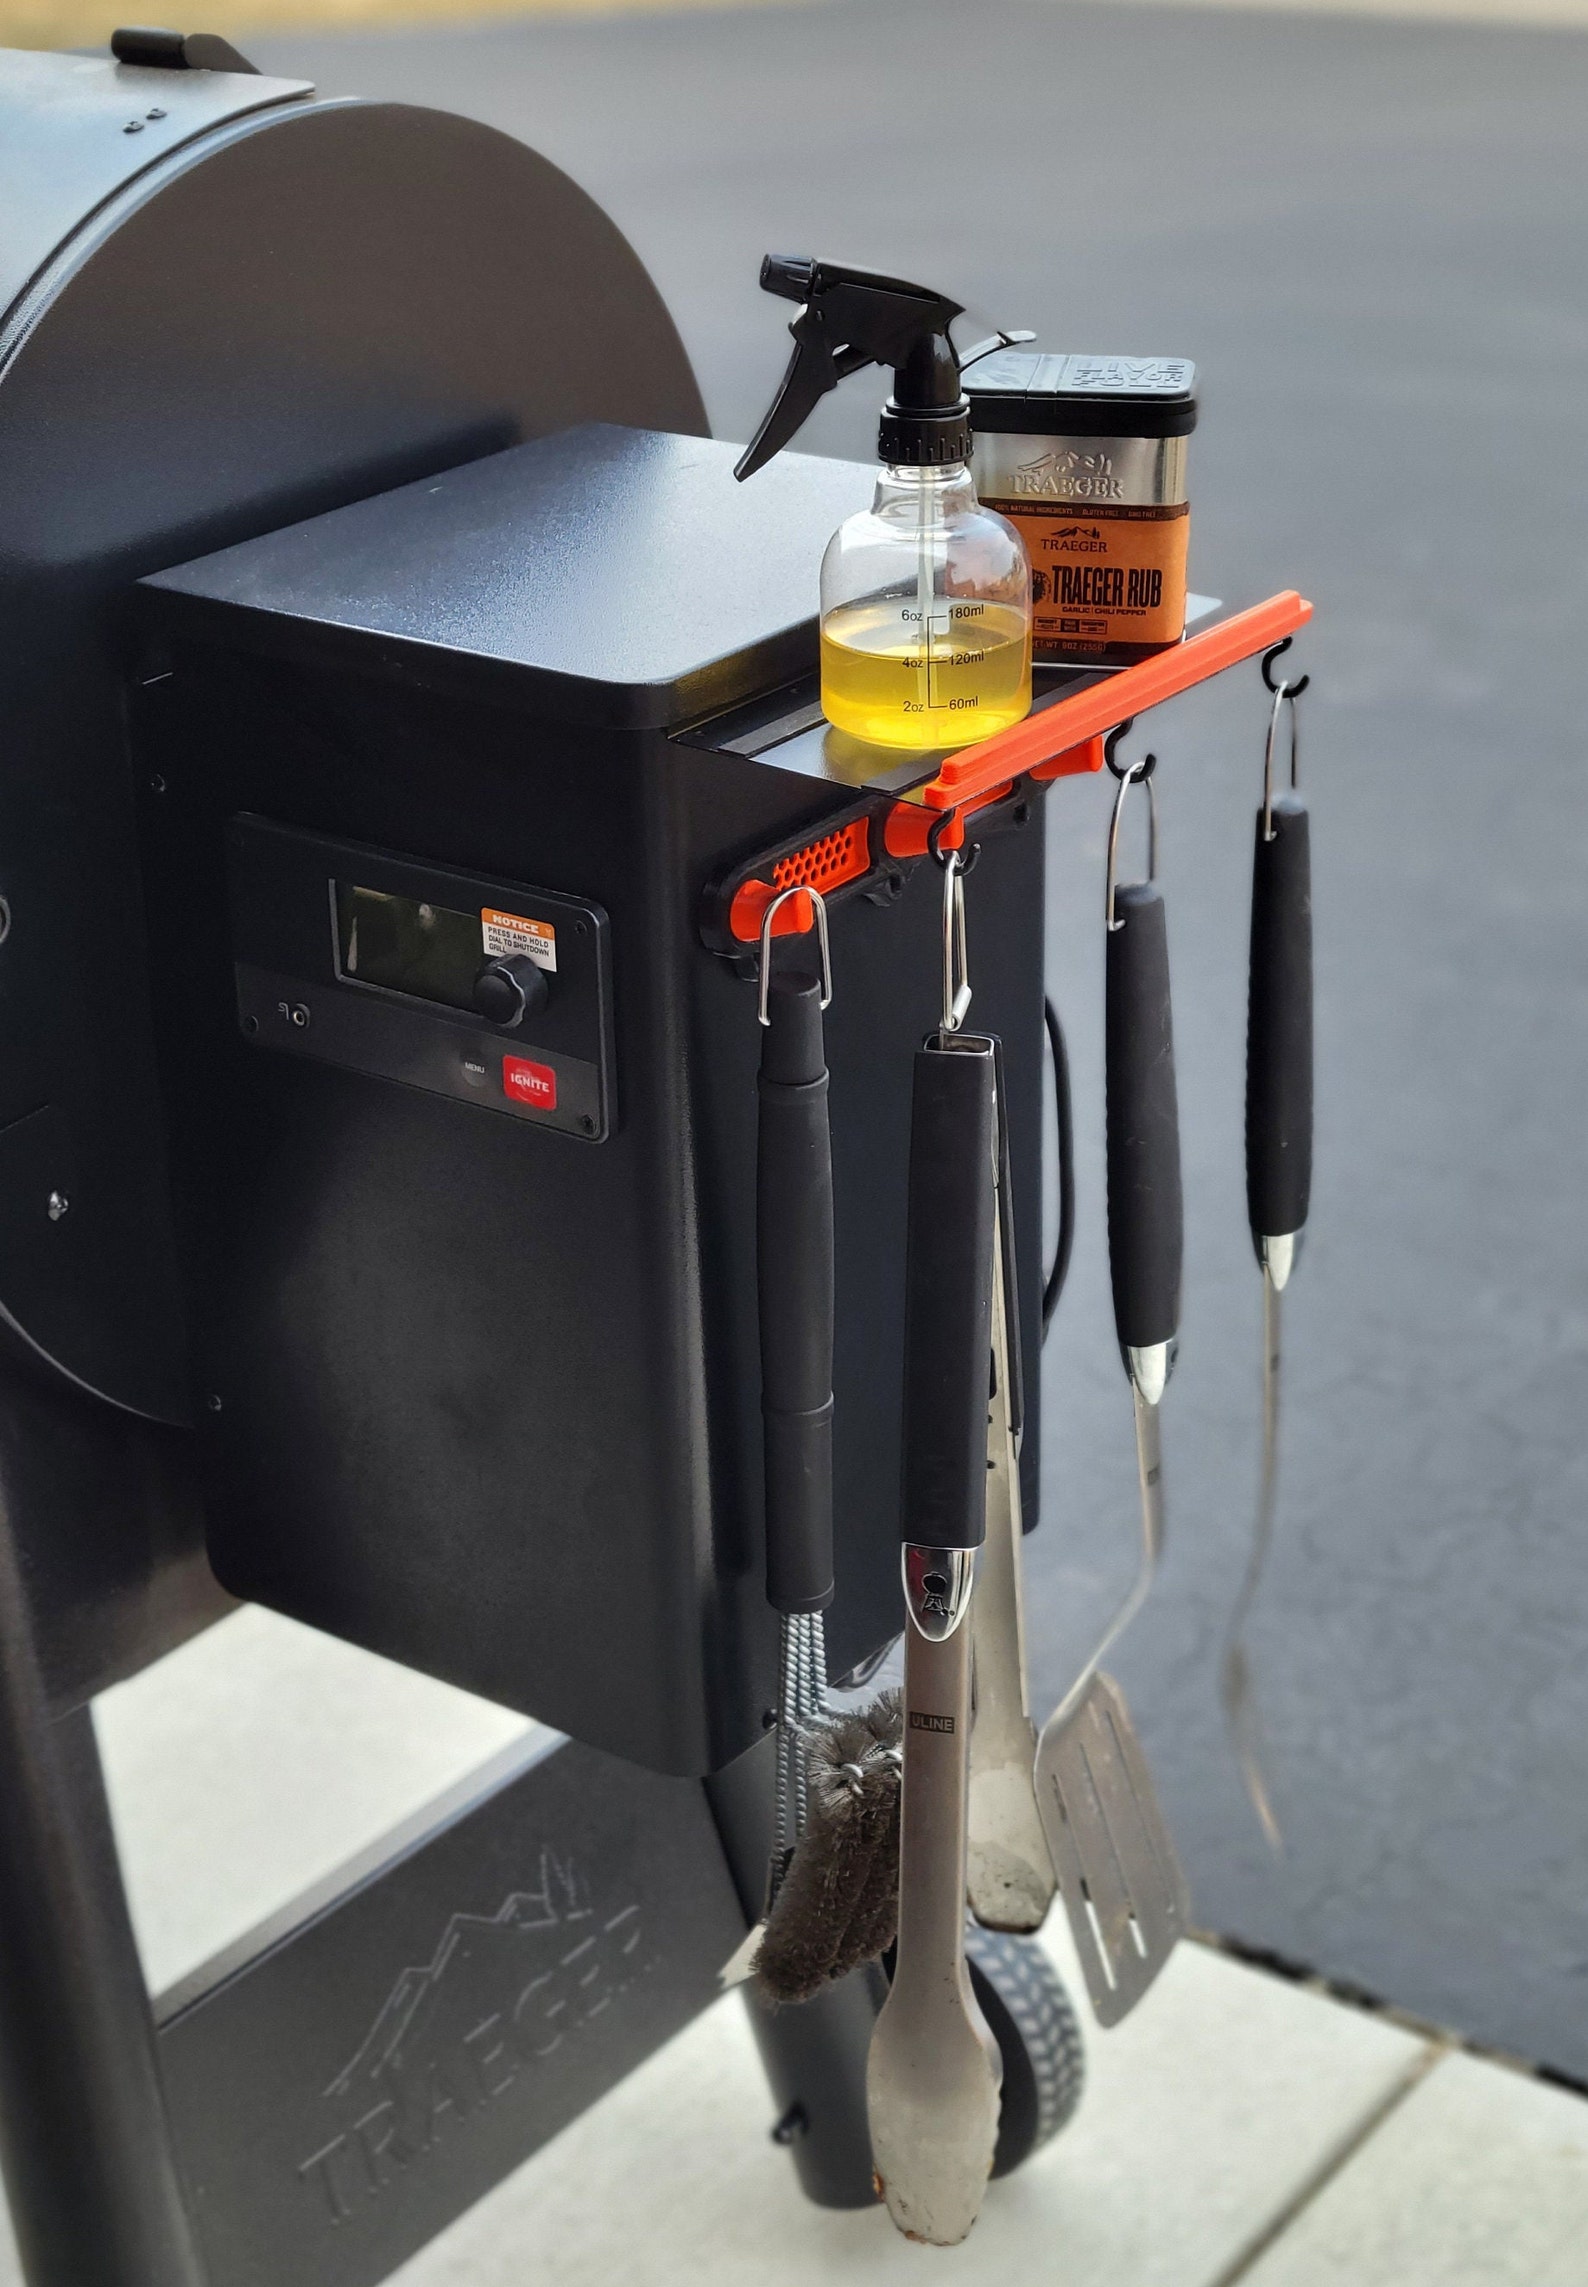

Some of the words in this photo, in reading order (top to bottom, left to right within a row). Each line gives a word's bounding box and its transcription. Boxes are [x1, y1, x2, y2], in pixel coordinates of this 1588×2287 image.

[1007, 474, 1125, 499] TRAEGER
[1040, 538, 1108, 553] TRAEGER
[1052, 565, 1125, 607] TRAEGER
[1127, 568, 1163, 608] RUB
[901, 609, 923, 622] 6oz
[949, 604, 984, 619] 180ml
[1062, 606, 1090, 614] GARLIC
[1094, 607, 1115, 615] CHILI
[1116, 608, 1147, 616] PEPPER
[902, 657, 924, 669] 4oz
[949, 652, 984, 666] 120ml
[903, 700, 925, 712] 2oz
[949, 696, 979, 710] 60ml
[492, 914, 540, 934] NOTICE
[487, 926, 511, 938] PRESS
[513, 933, 528, 943] AND
[529, 937, 549, 948] HOLD
[488, 934, 503, 944] DIAL
[504, 939, 512, 947] TO
[513, 940, 550, 957] SHUTDOWN
[488, 942, 507, 954] GRILL
[464, 1062, 485, 1074] MENU
[510, 1072, 550, 1093] IGNITE
[911, 1713, 954, 1732] ULINE
